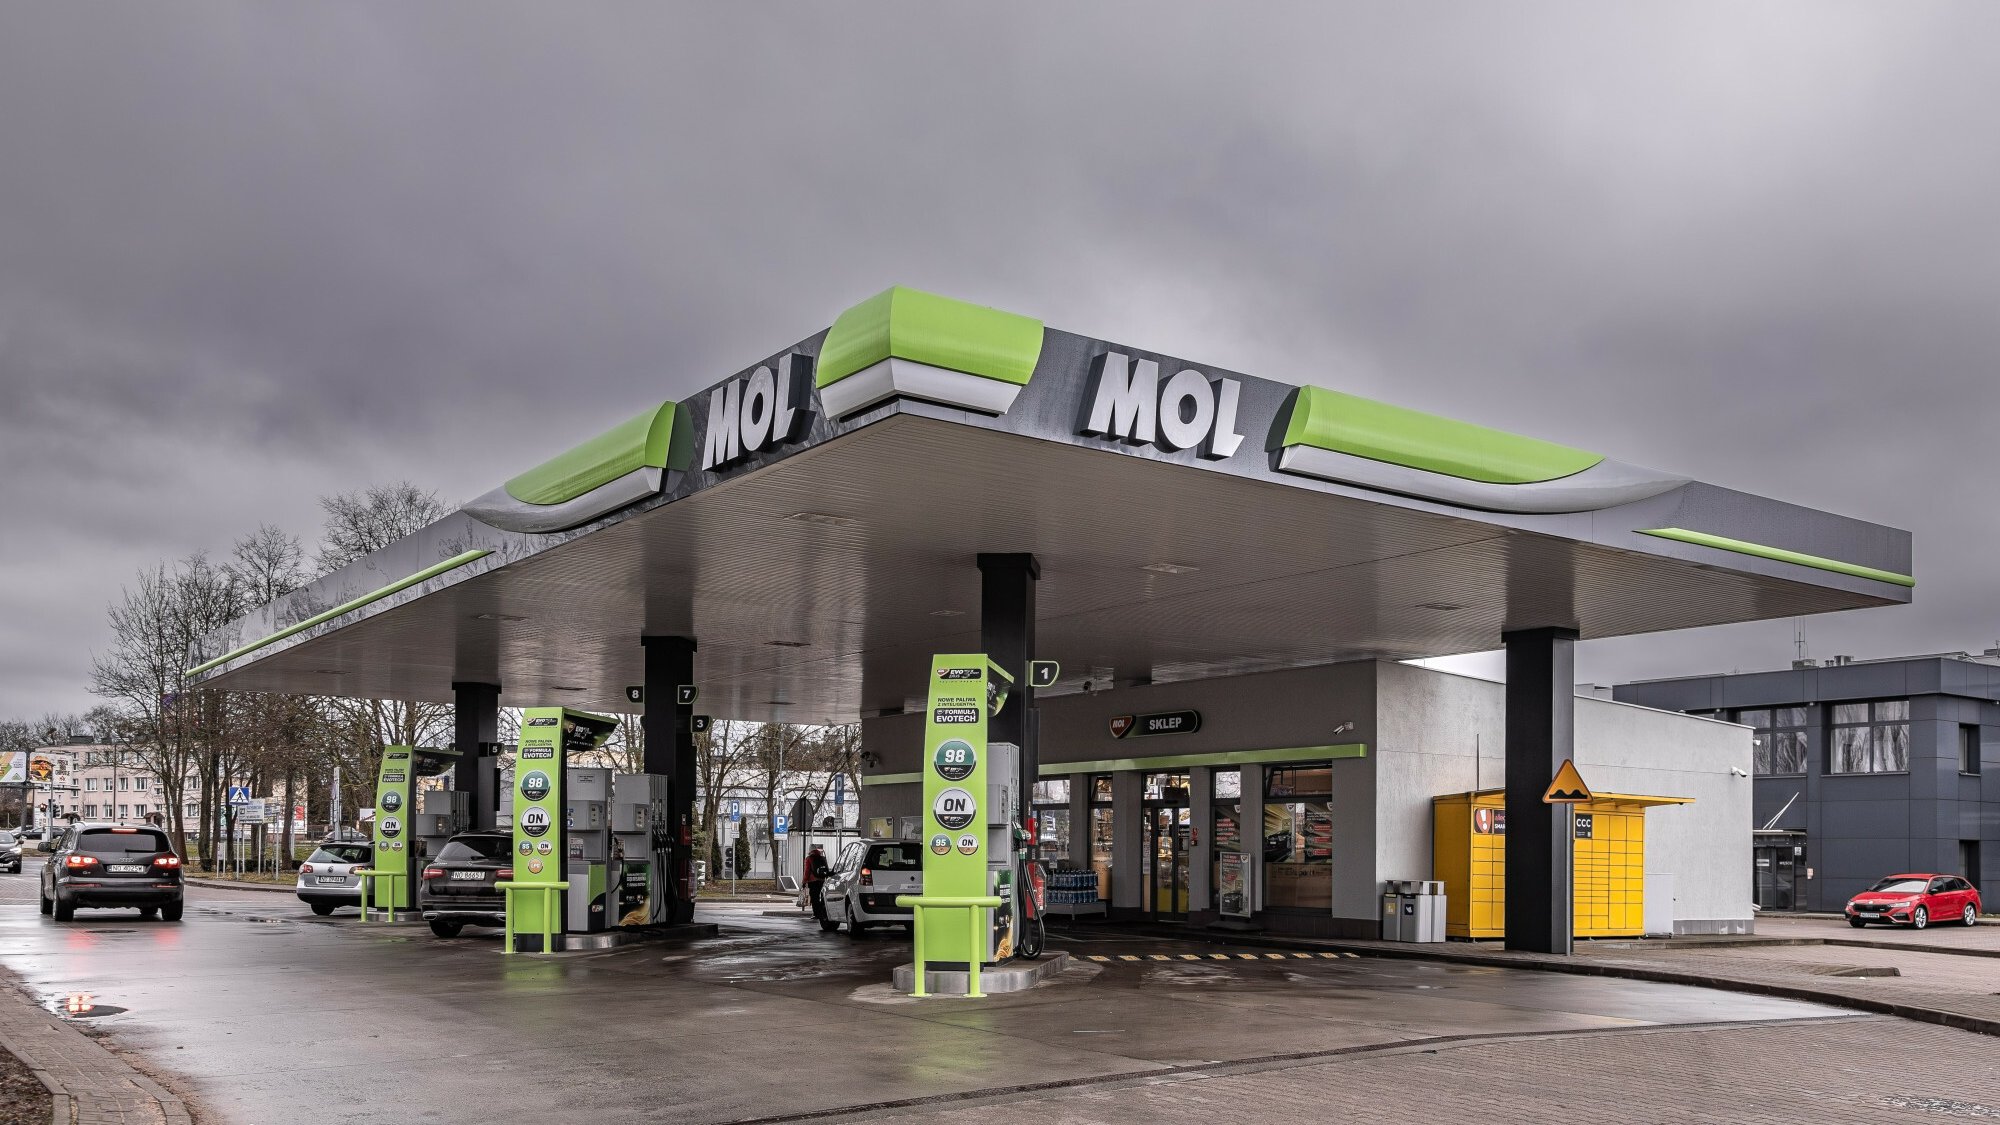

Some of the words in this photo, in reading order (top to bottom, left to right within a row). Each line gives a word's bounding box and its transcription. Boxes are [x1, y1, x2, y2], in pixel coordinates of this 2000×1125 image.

[1087, 351, 1245, 457] MOL
[702, 353, 795, 470] MOL
[1041, 667, 1049, 680] 1
[632, 689, 639, 699] 8
[683, 689, 691, 699] 7
[696, 719, 704, 728] 3
[936, 715, 976, 723] EVOTECH
[1149, 717, 1182, 731] SKLEP
[492, 745, 498, 753] 5
[945, 749, 966, 763] 98
[528, 777, 544, 788] 98
[386, 795, 398, 804] 98
[732, 802, 739, 815] P
[943, 798, 966, 812] ON
[527, 813, 544, 824] ON
[776, 816, 785, 829] P
[1576, 818, 1591, 828] CCC
[385, 821, 397, 829] ON
[935, 839, 947, 847] 95
[961, 838, 973, 846] ON
